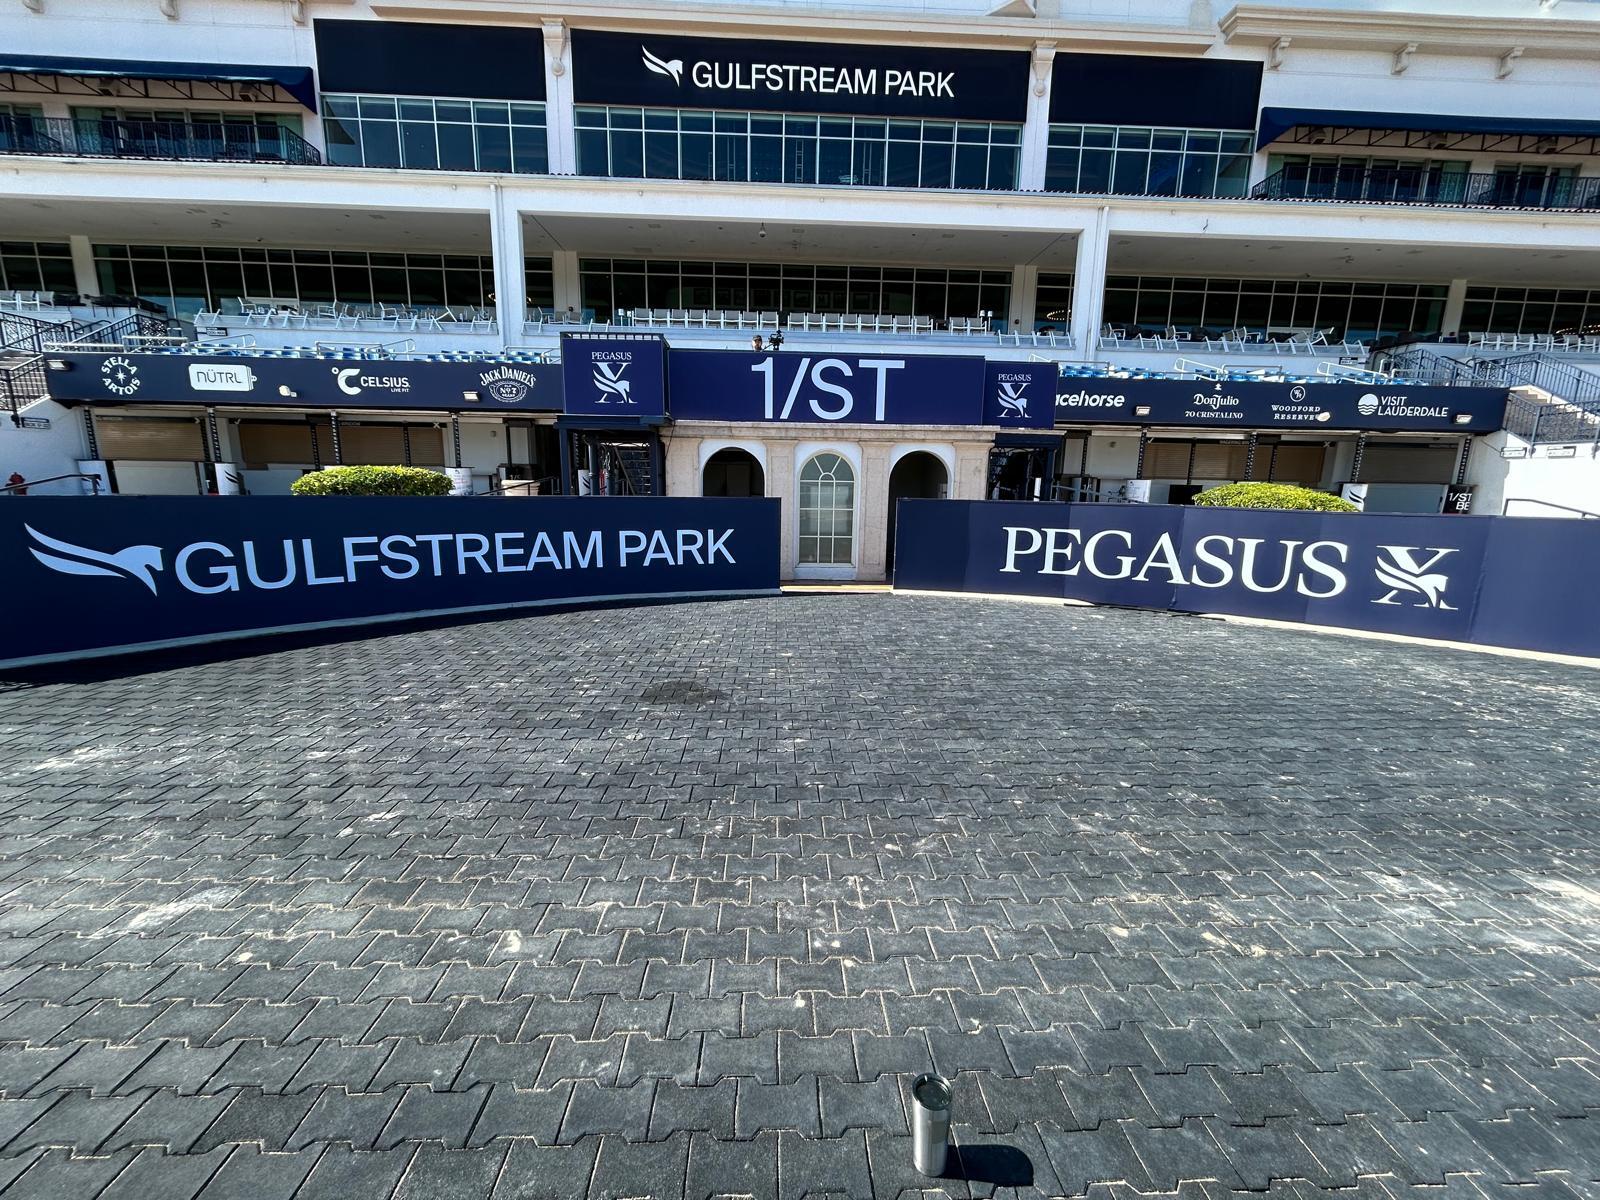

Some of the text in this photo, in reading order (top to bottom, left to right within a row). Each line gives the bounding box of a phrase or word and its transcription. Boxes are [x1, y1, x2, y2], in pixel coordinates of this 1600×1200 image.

[691, 61, 956, 98] GULFSTREAM PARK
[591, 352, 632, 360] PEGASUS
[101, 356, 138, 375] STELLA
[360, 376, 409, 388] CELSIUS
[479, 365, 537, 388] JACK DANIEL'S
[998, 373, 1032, 382] PEGASUS
[102, 377, 141, 396] ARTOIS
[752, 357, 905, 421] 1/ST
[1381, 396, 1407, 406] VISIT
[1271, 404, 1321, 412] WOODFORD
[1377, 406, 1449, 417] LAUDERDALE
[1196, 411, 1244, 419] CRISTALINO
[1273, 413, 1316, 421] RESERVE
[174, 528, 737, 595] GULFSTREAM PARK
[1000, 526, 1349, 598] PEGASUS
